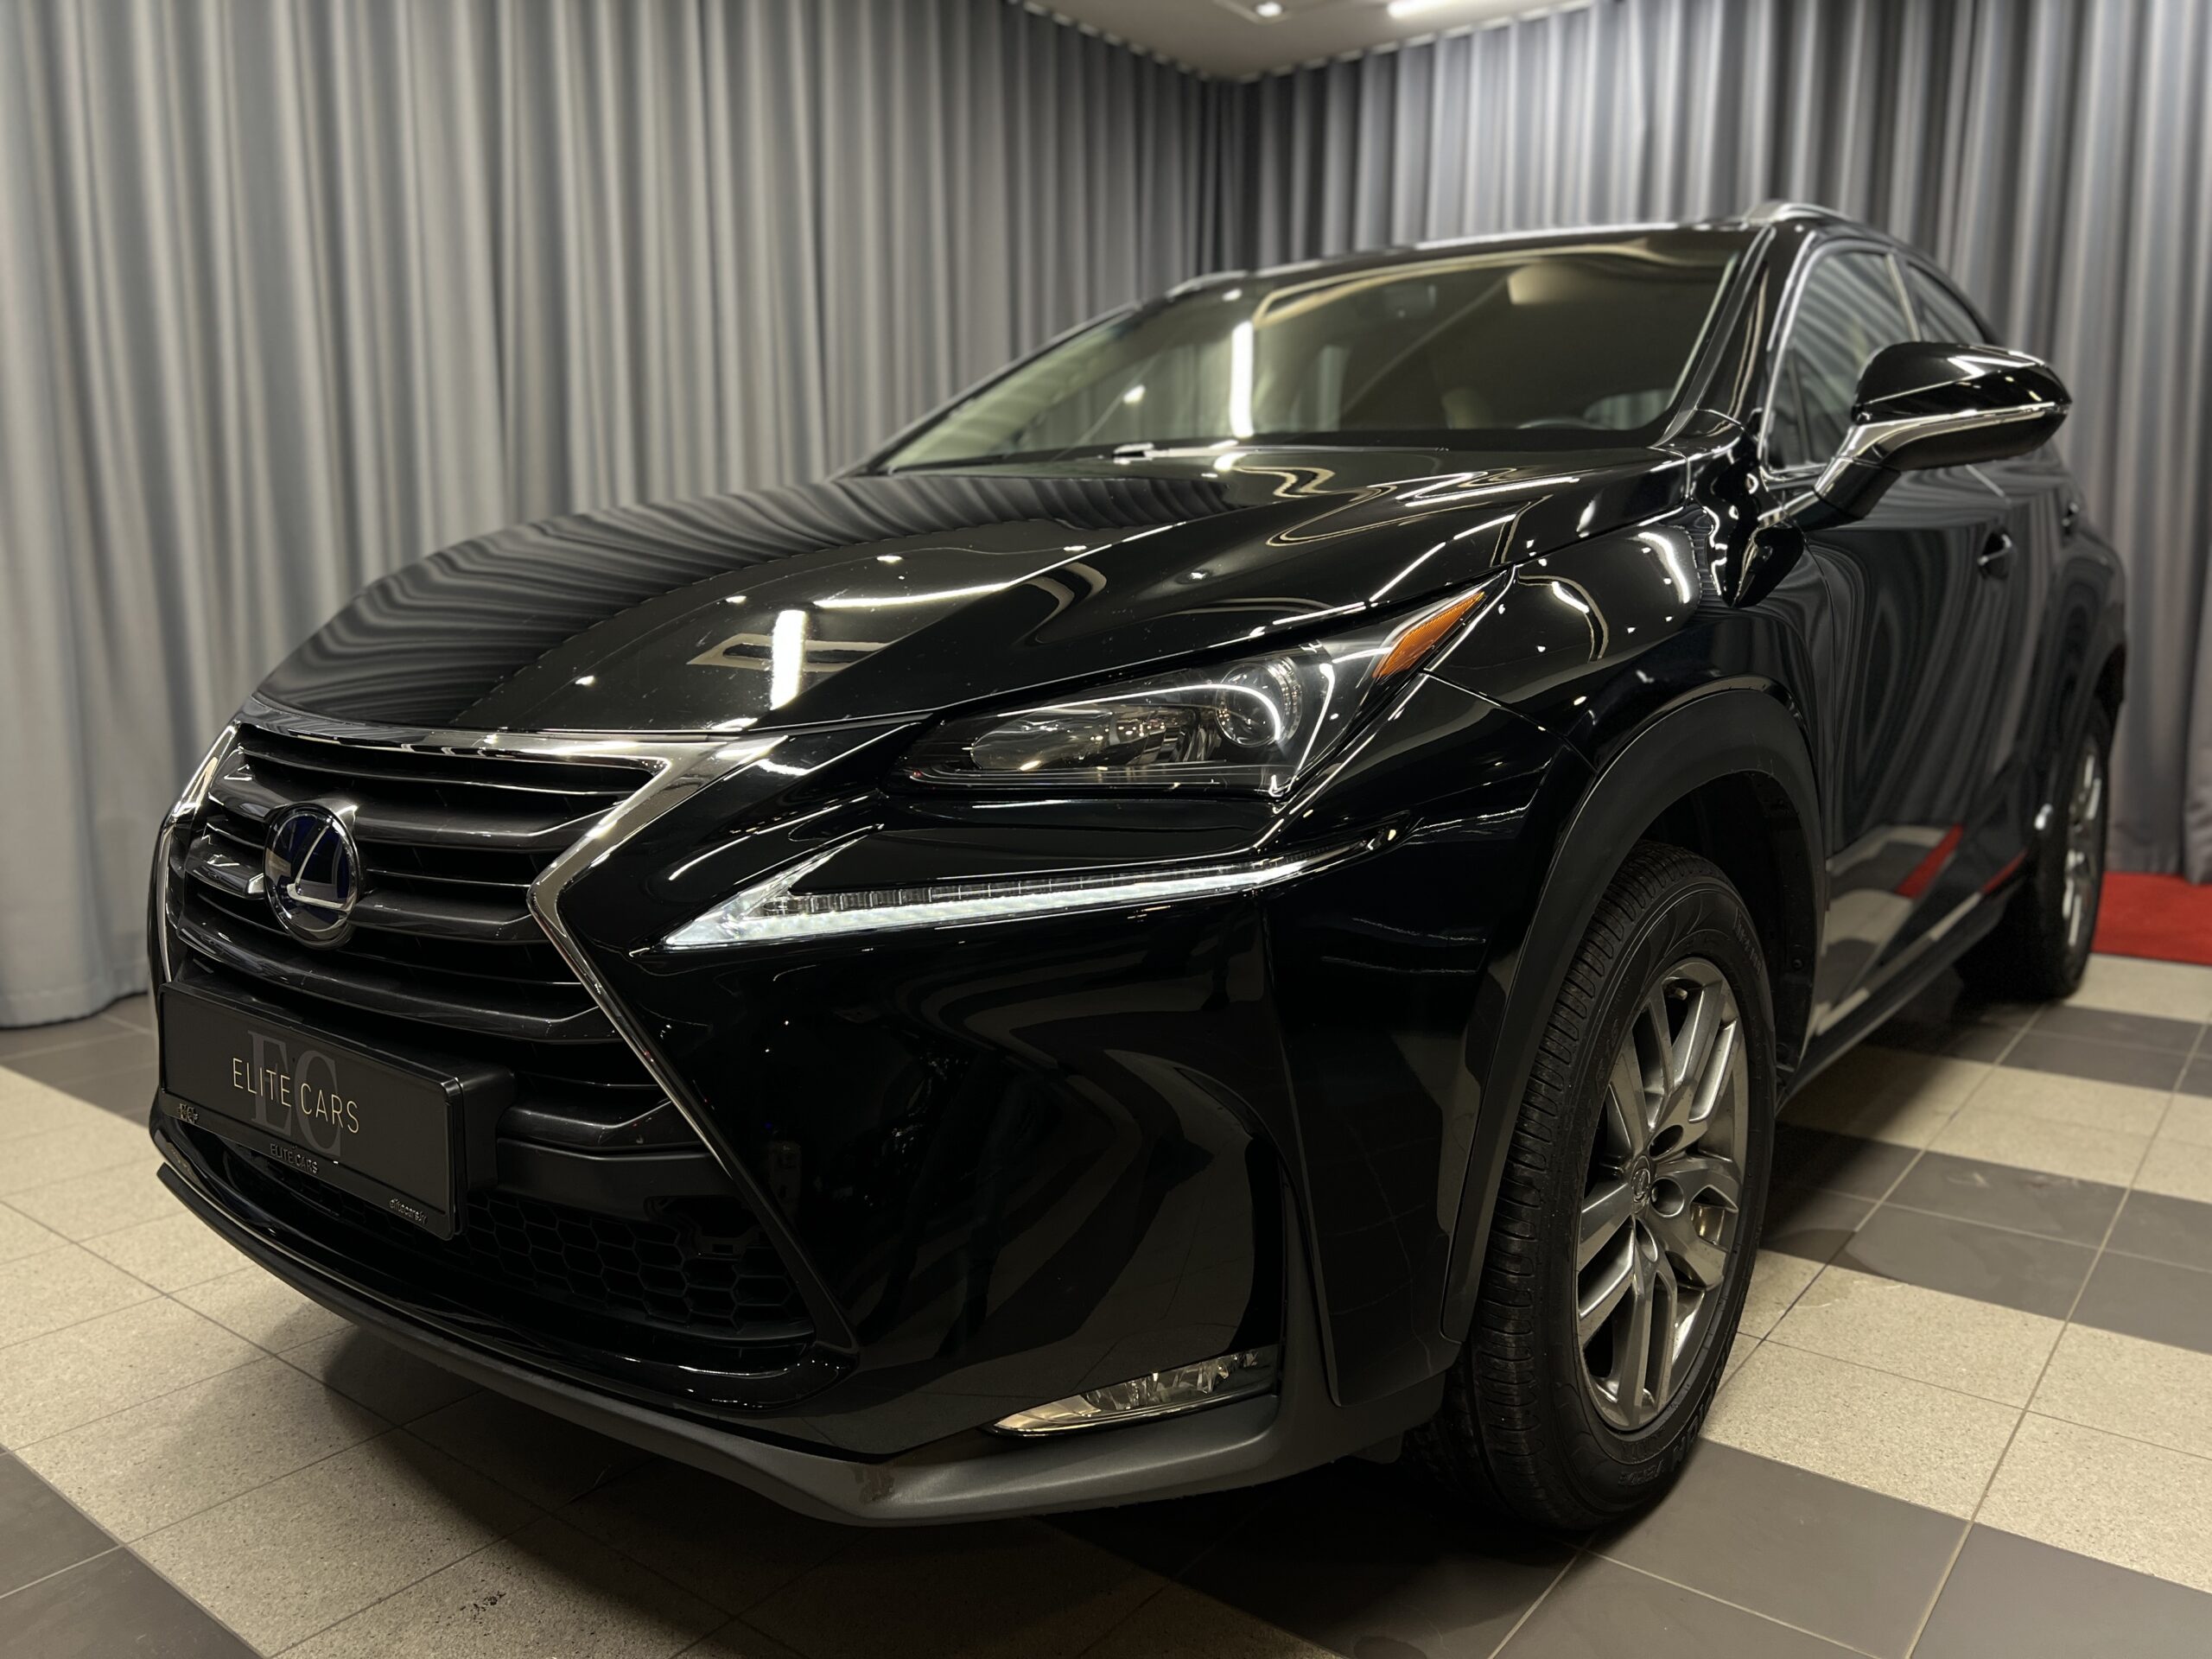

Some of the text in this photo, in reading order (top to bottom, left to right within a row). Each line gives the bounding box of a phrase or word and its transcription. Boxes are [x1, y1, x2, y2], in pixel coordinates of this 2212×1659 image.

[232, 1057, 360, 1135] ELITE CARS
[270, 1142, 318, 1174] ELITE CARS
